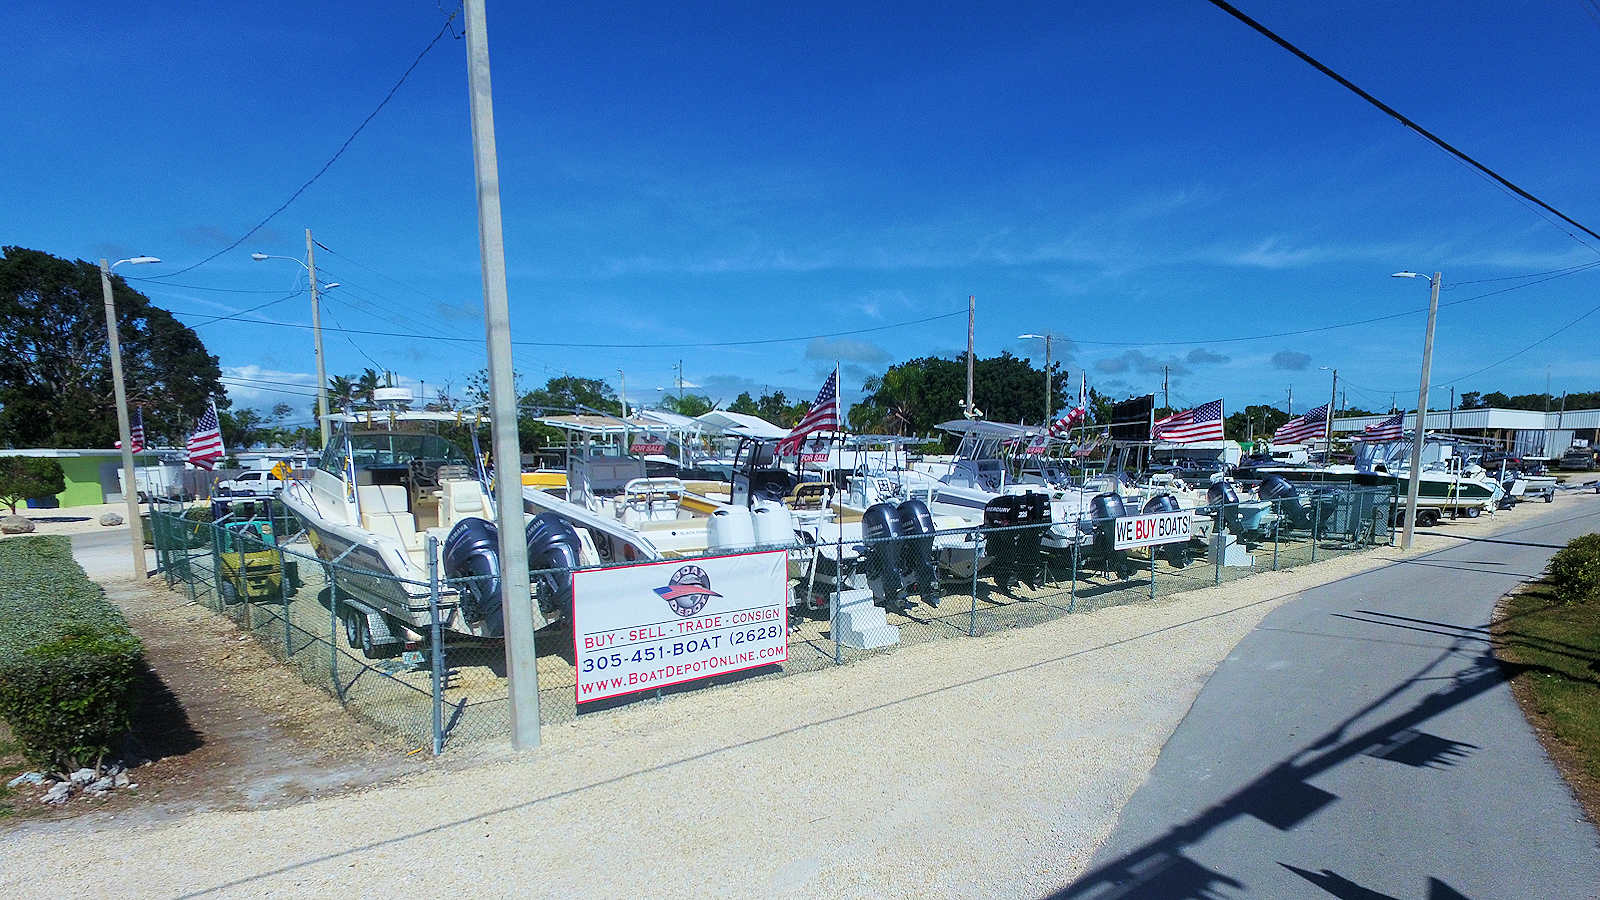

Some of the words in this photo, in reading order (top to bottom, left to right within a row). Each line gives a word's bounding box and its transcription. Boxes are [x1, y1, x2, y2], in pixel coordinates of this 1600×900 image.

[646, 445, 665, 453] SALE
[527, 519, 545, 536] AMAHA
[1117, 521, 1133, 541] WE
[1135, 518, 1156, 540] BUY
[1159, 515, 1191, 537] BOATS!
[672, 566, 706, 581] BOAT
[670, 596, 707, 615] DEPOT
[584, 633, 616, 649] BUY
[629, 627, 666, 641] SELL
[677, 616, 722, 634] TRADE
[732, 608, 780, 624] CONSIGN
[582, 635, 722, 673] 305-451-BOAT
[729, 624, 783, 646] (2628)
